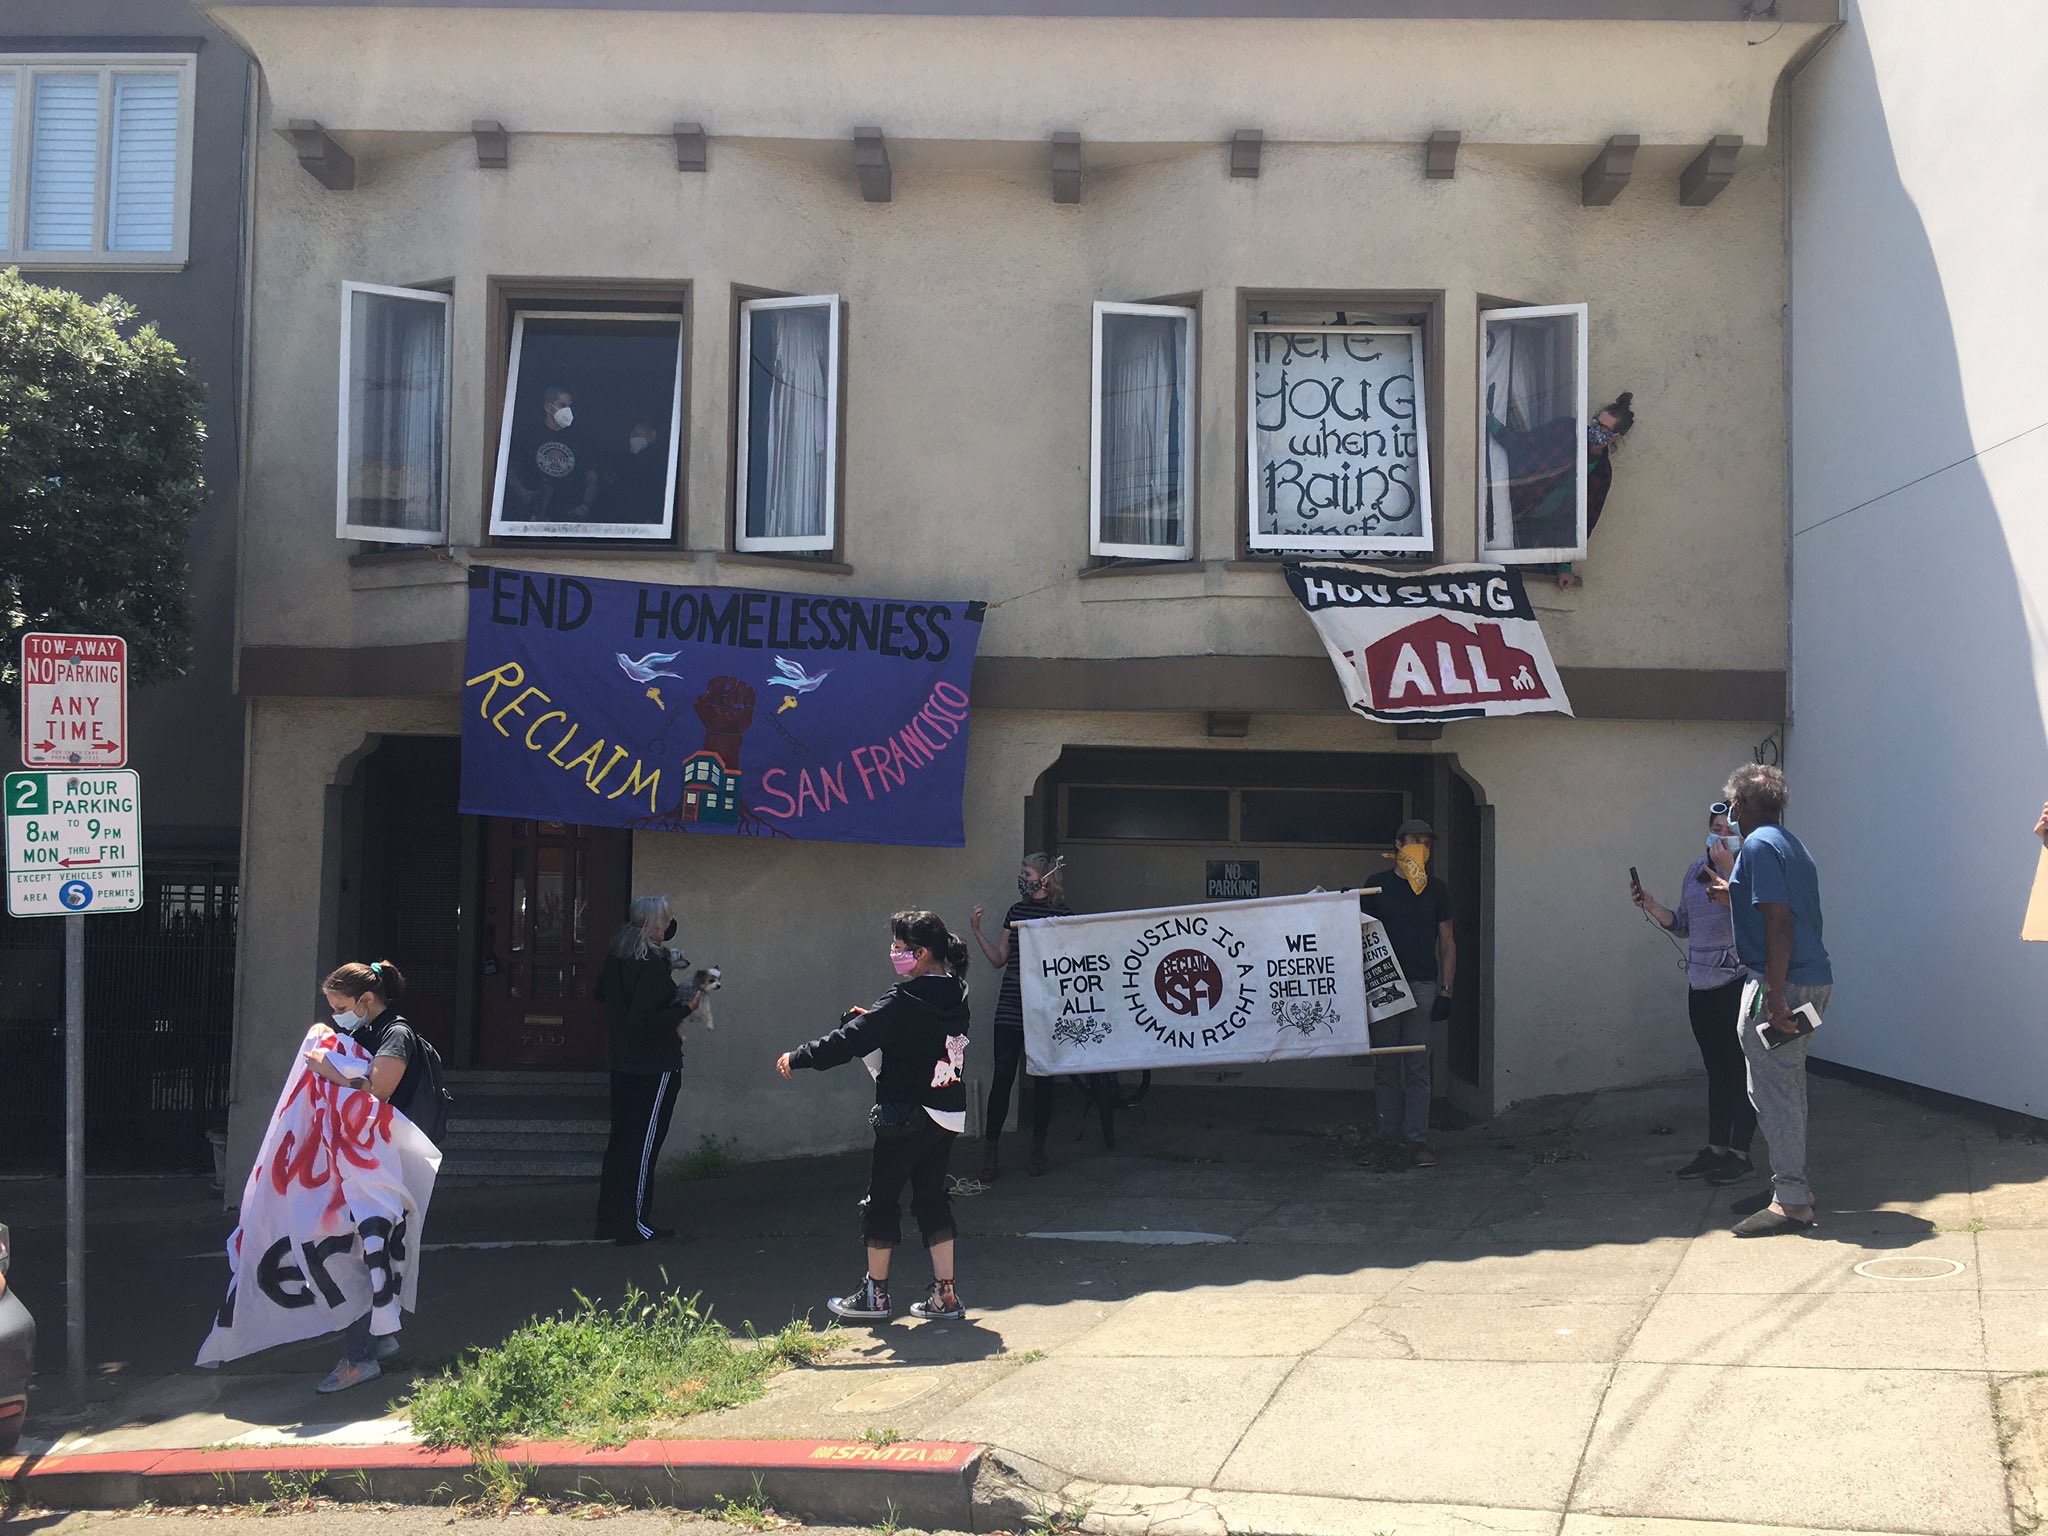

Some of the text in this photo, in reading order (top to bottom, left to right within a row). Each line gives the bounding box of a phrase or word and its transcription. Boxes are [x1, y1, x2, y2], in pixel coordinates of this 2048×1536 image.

[1288, 418, 1388, 459] when
[1304, 577, 1515, 612] HOUSING
[491, 571, 953, 663] END HOMELESSNESS
[31, 638, 118, 657] TOW-AWAY
[27, 657, 119, 683] NO PARKING
[1388, 641, 1502, 699] ALL
[50, 695, 100, 716] ANY
[45, 720, 104, 741] TIME
[465, 661, 663, 813] RECLAIM
[753, 680, 970, 818] SAN FRANCISCO
[16, 780, 118, 809] 2 HOUR
[52, 798, 133, 815] PARKING
[68, 819, 80, 828] TO
[23, 845, 125, 863] MON THRU FRI
[17, 870, 133, 884] EXCEPT VEHICLES WITH
[1224, 863, 1241, 880] NO
[23, 884, 135, 906] AREA S PERMITS
[1208, 879, 1258, 896] PARKING
[1122, 917, 1254, 989] HOUSING IS A
[1285, 933, 1318, 954] WE
[1042, 954, 1111, 978] HOMES
[1267, 956, 1336, 977] DESERVE
[1059, 974, 1104, 997] FOR
[1268, 976, 1338, 999] SHELTER
[1062, 997, 1106, 1016] ALL
[1123, 983, 1257, 1049] HUMAN RIGHT
[831, 1446, 926, 1462] SFMTA
